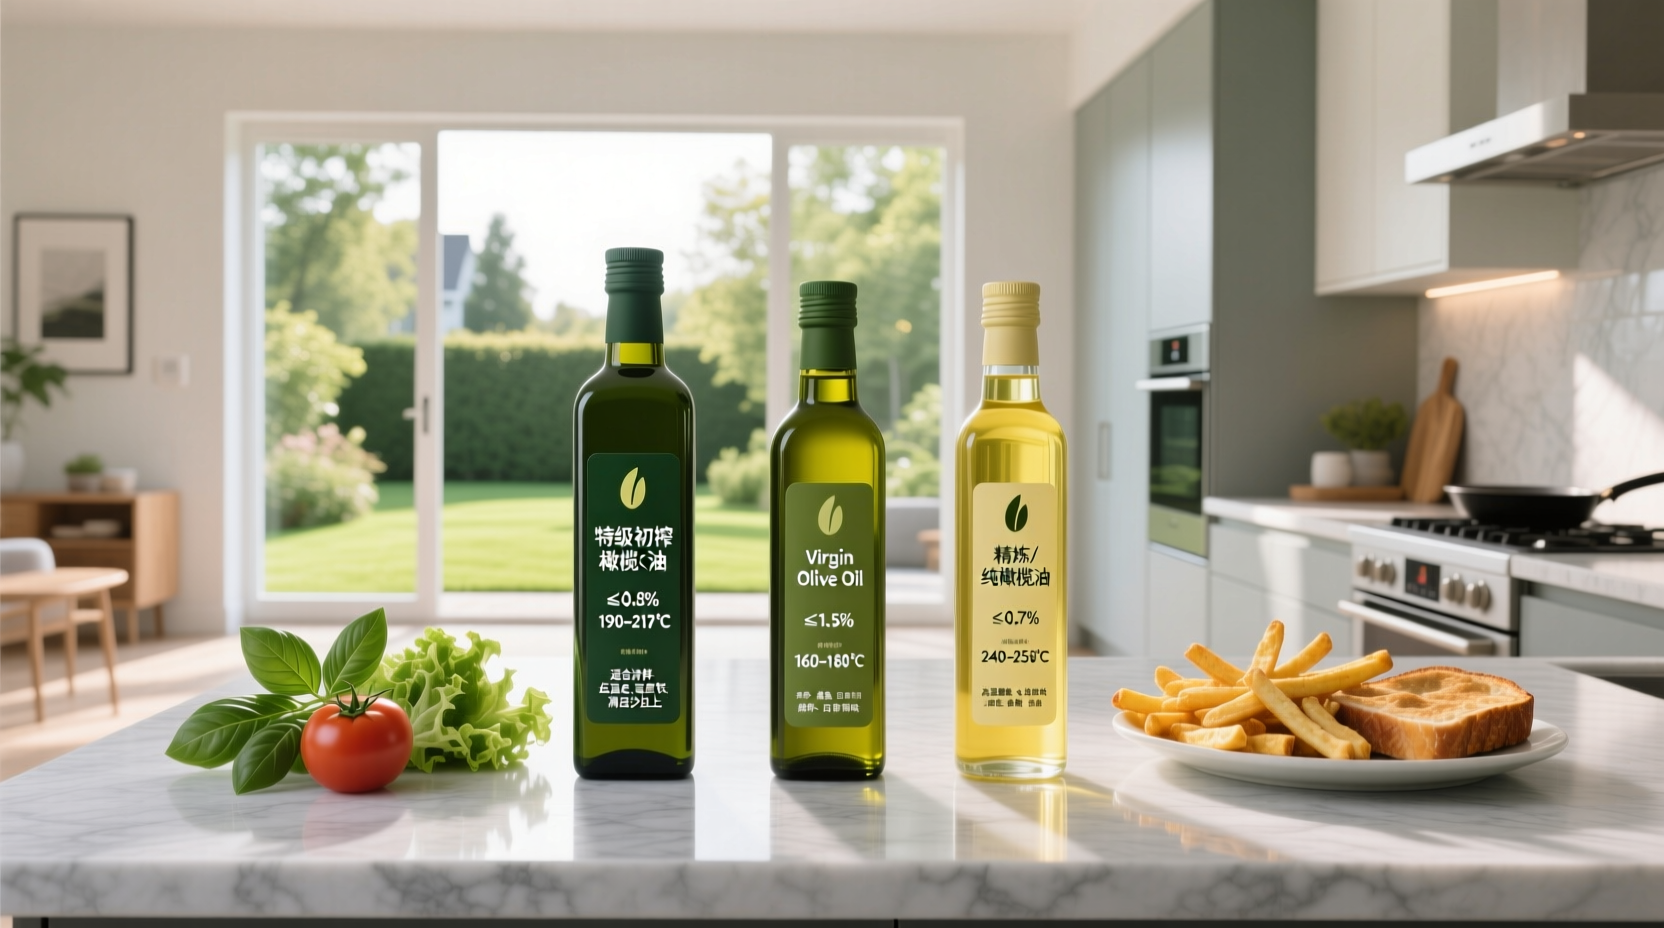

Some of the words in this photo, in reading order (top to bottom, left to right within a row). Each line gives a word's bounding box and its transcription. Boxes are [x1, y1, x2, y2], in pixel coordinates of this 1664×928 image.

[805, 548, 854, 569] Virgin
[797, 569, 838, 587] Olive
[841, 569, 863, 587] Oil
[804, 612, 855, 628] ≤1.5%
[992, 610, 1040, 625] ≤0.7%
